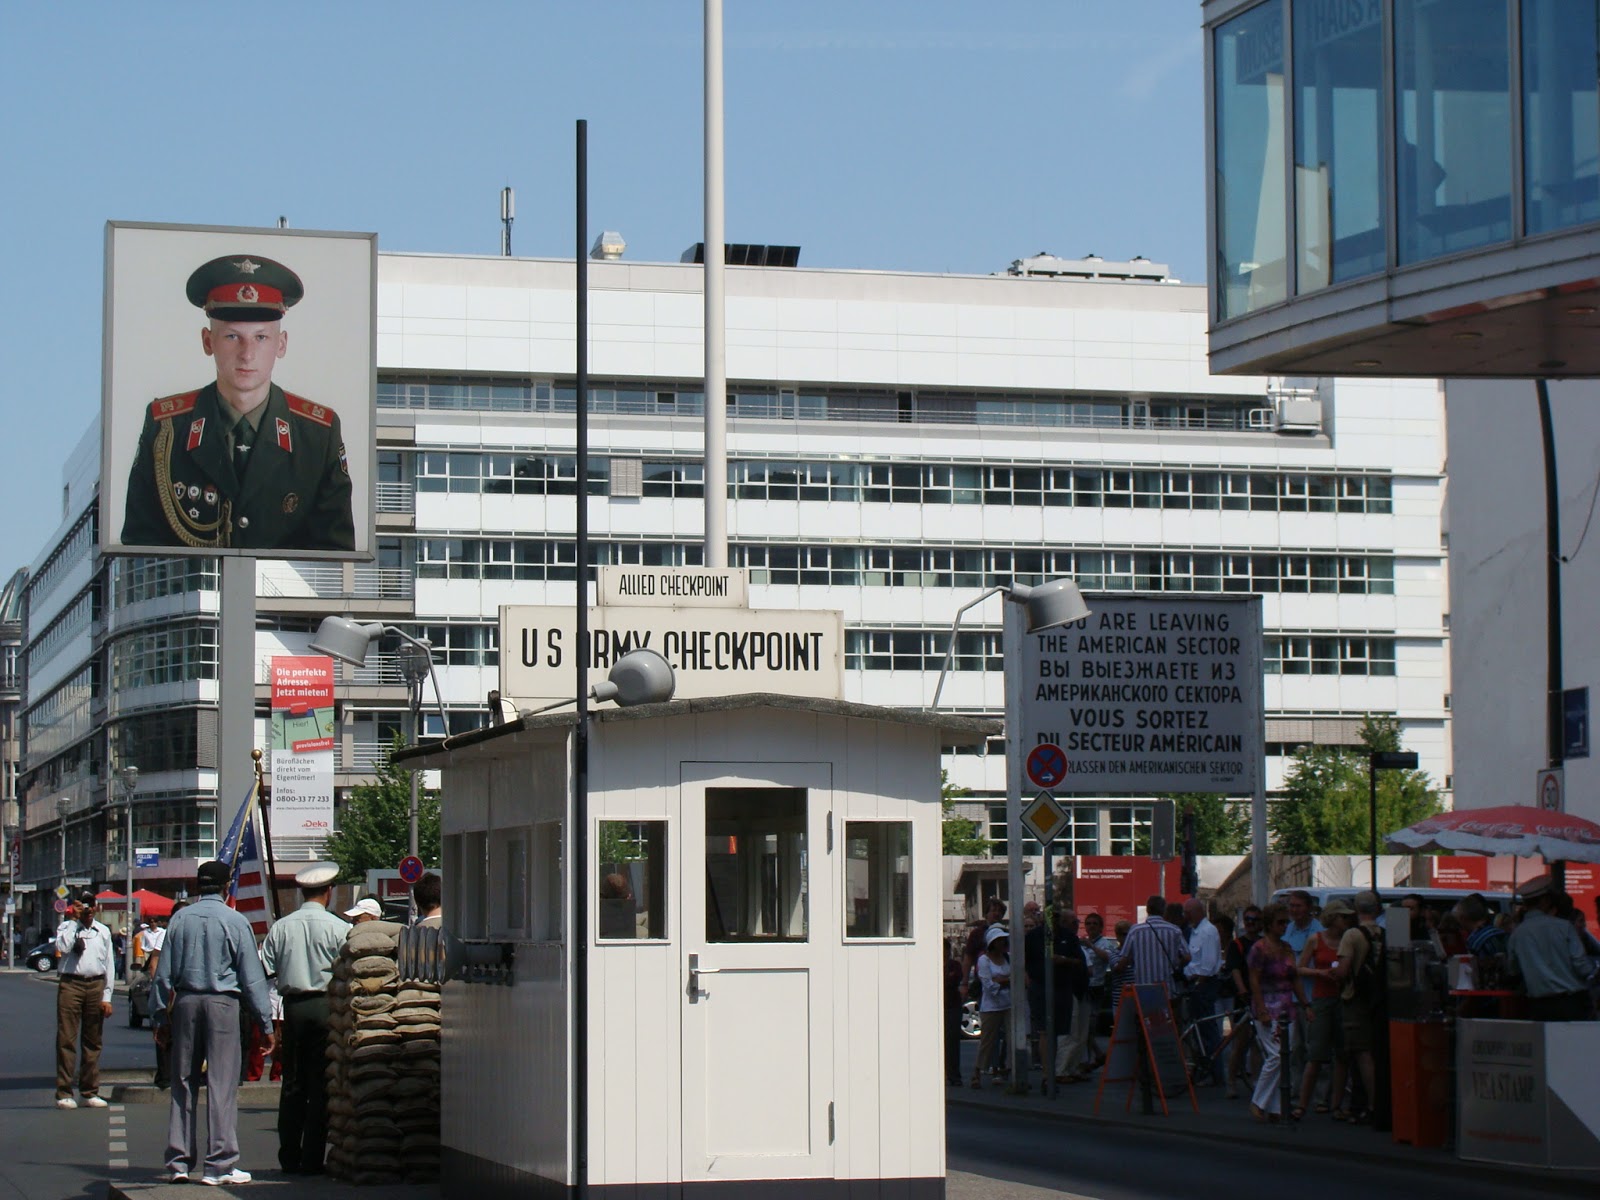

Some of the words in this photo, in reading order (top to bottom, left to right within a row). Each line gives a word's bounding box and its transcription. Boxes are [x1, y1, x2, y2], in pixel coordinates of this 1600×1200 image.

[618, 574, 656, 596] ALLIED
[660, 575, 730, 597] CHECKPOINT
[1099, 612, 1137, 630] ARE
[1150, 613, 1230, 632] LEAVING
[576, 629, 652, 669] RMY
[663, 631, 824, 671] CHECKPOINT
[1037, 634, 1068, 653] THE
[1078, 636, 1167, 654] AMERICAN
[1177, 637, 1241, 655] SECTOR
[276, 667, 291, 677] Die
[292, 668, 327, 679] perfekte
[1040, 660, 1070, 678] ВЫ
[1082, 660, 1199, 680] ВЫЕЗЖАЕТЕ
[1211, 662, 1236, 681] ИЗ
[276, 678, 312, 687] Adresse.
[276, 688, 296, 698] Jetzt
[297, 688, 329, 697] mieten!
[1035, 683, 1168, 702] АМЕРИКАНСКОГО
[1175, 685, 1243, 703] СЕКТОРА
[1070, 708, 1125, 728] VOUS
[1136, 709, 1209, 729] SORTEZ
[295, 740, 331, 750] provisionsfrei
[1068, 732, 1144, 752] SECTEUR
[1149, 731, 1242, 753] AMÉRICAIN
[276, 757, 315, 765] Büroflächen
[1108, 761, 1127, 774] DEN
[1129, 761, 1207, 775] AMERIKANISCHEN
[1209, 761, 1244, 776] SEKTOR
[276, 773, 316, 782] Eigentümer!
[276, 786, 296, 794] Infos:
[276, 795, 307, 803] 0800-33
[308, 795, 316, 803] 77
[317, 795, 330, 803] 233
[305, 819, 328, 828] Deka
